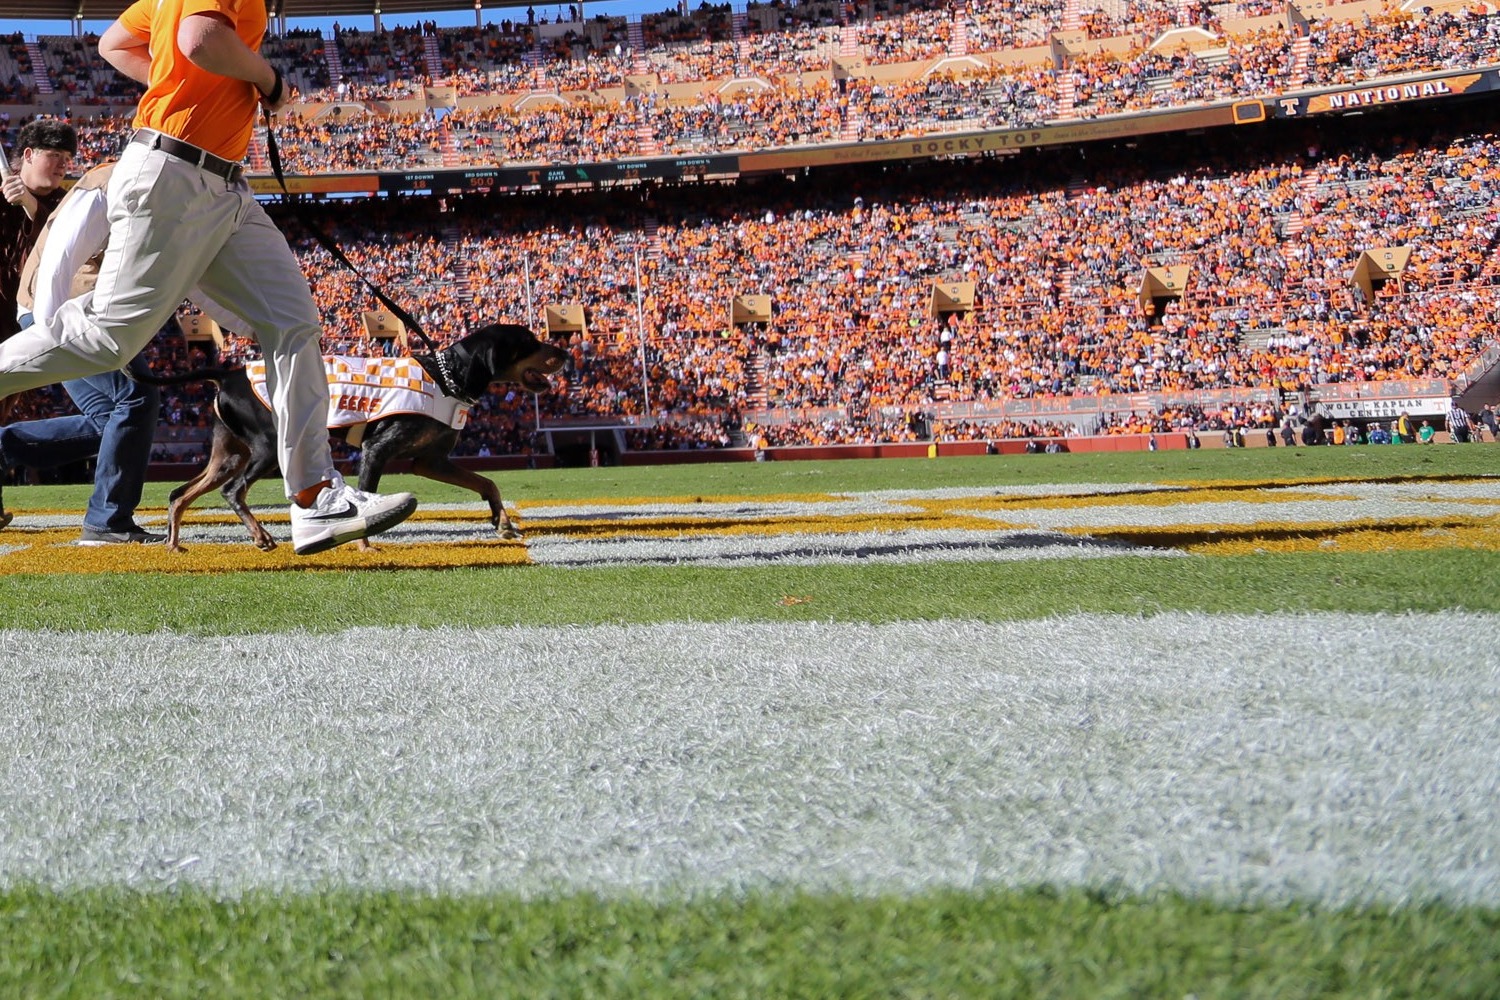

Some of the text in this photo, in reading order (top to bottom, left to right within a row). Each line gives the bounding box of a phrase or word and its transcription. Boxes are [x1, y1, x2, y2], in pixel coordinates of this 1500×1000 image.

[1329, 81, 1451, 108] NATIONAL
[1280, 98, 1299, 115] T
[912, 138, 985, 154] ROCKY
[999, 132, 1042, 146] TOP
[527, 171, 541, 184] T
[625, 169, 639, 179] 12
[413, 180, 427, 190] 18
[470, 177, 494, 187] 50.0
[331, 394, 382, 413] TEERS
[1325, 402, 1359, 411] WOLF
[1373, 400, 1423, 409] KAPLAN
[1433, 401, 1444, 411] T
[1350, 408, 1397, 417] CENTER
